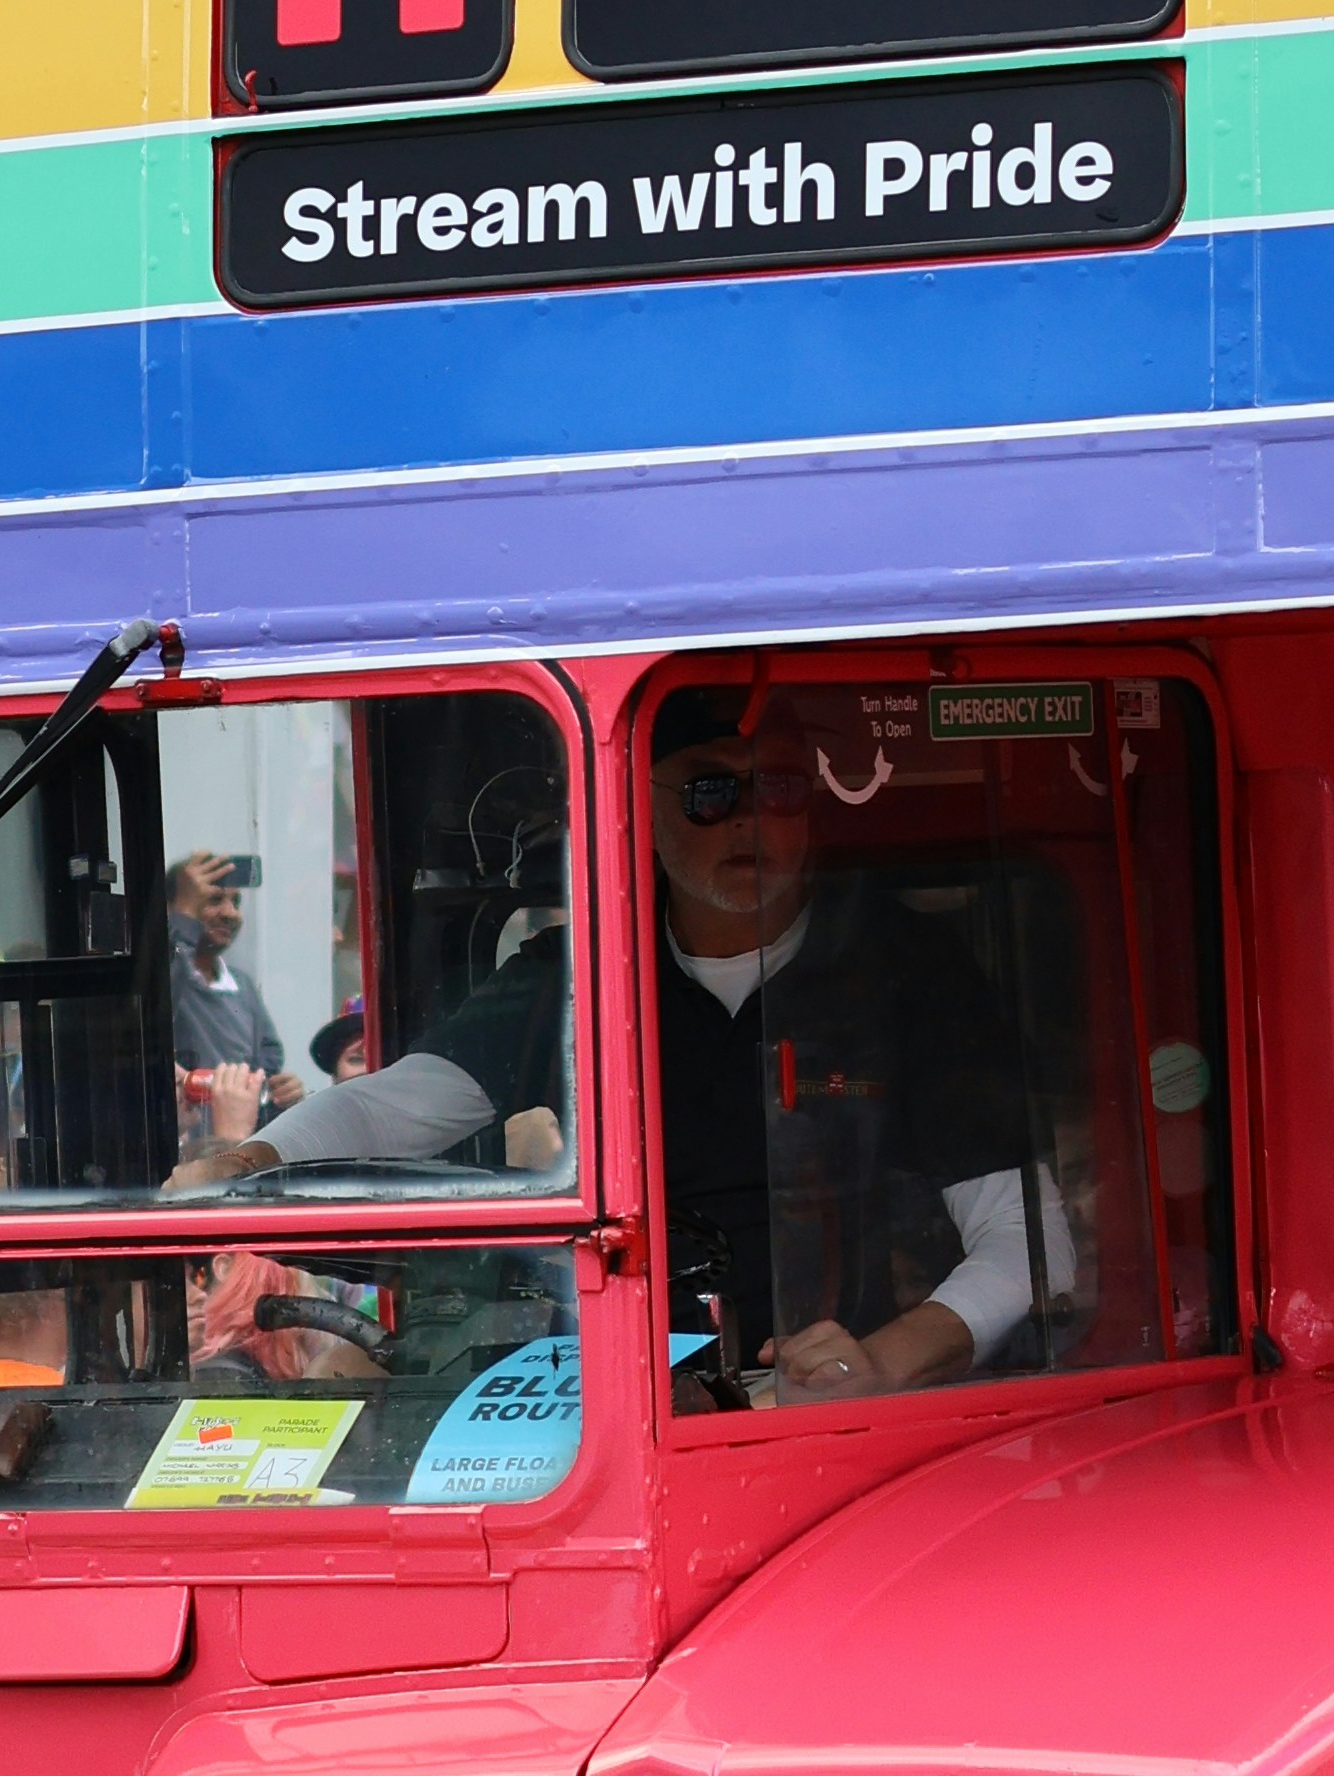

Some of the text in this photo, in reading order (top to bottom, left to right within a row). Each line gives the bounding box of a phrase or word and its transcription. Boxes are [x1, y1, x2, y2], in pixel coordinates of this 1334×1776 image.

[280, 120, 1115, 262] Stream with Pride
[860, 695, 918, 713] Turn Handle
[939, 696, 1039, 725] EMERGENCY
[1044, 695, 1083, 722] EXIT
[870, 720, 912, 738] To Open
[475, 1375, 581, 1398] BLU
[468, 1402, 582, 1422] ROUT
[262, 1426, 329, 1434] PARTICIPANT
[278, 1418, 320, 1426] PARADE
[430, 1456, 557, 1472] LARGE FLOA
[441, 1477, 487, 1492] AND
